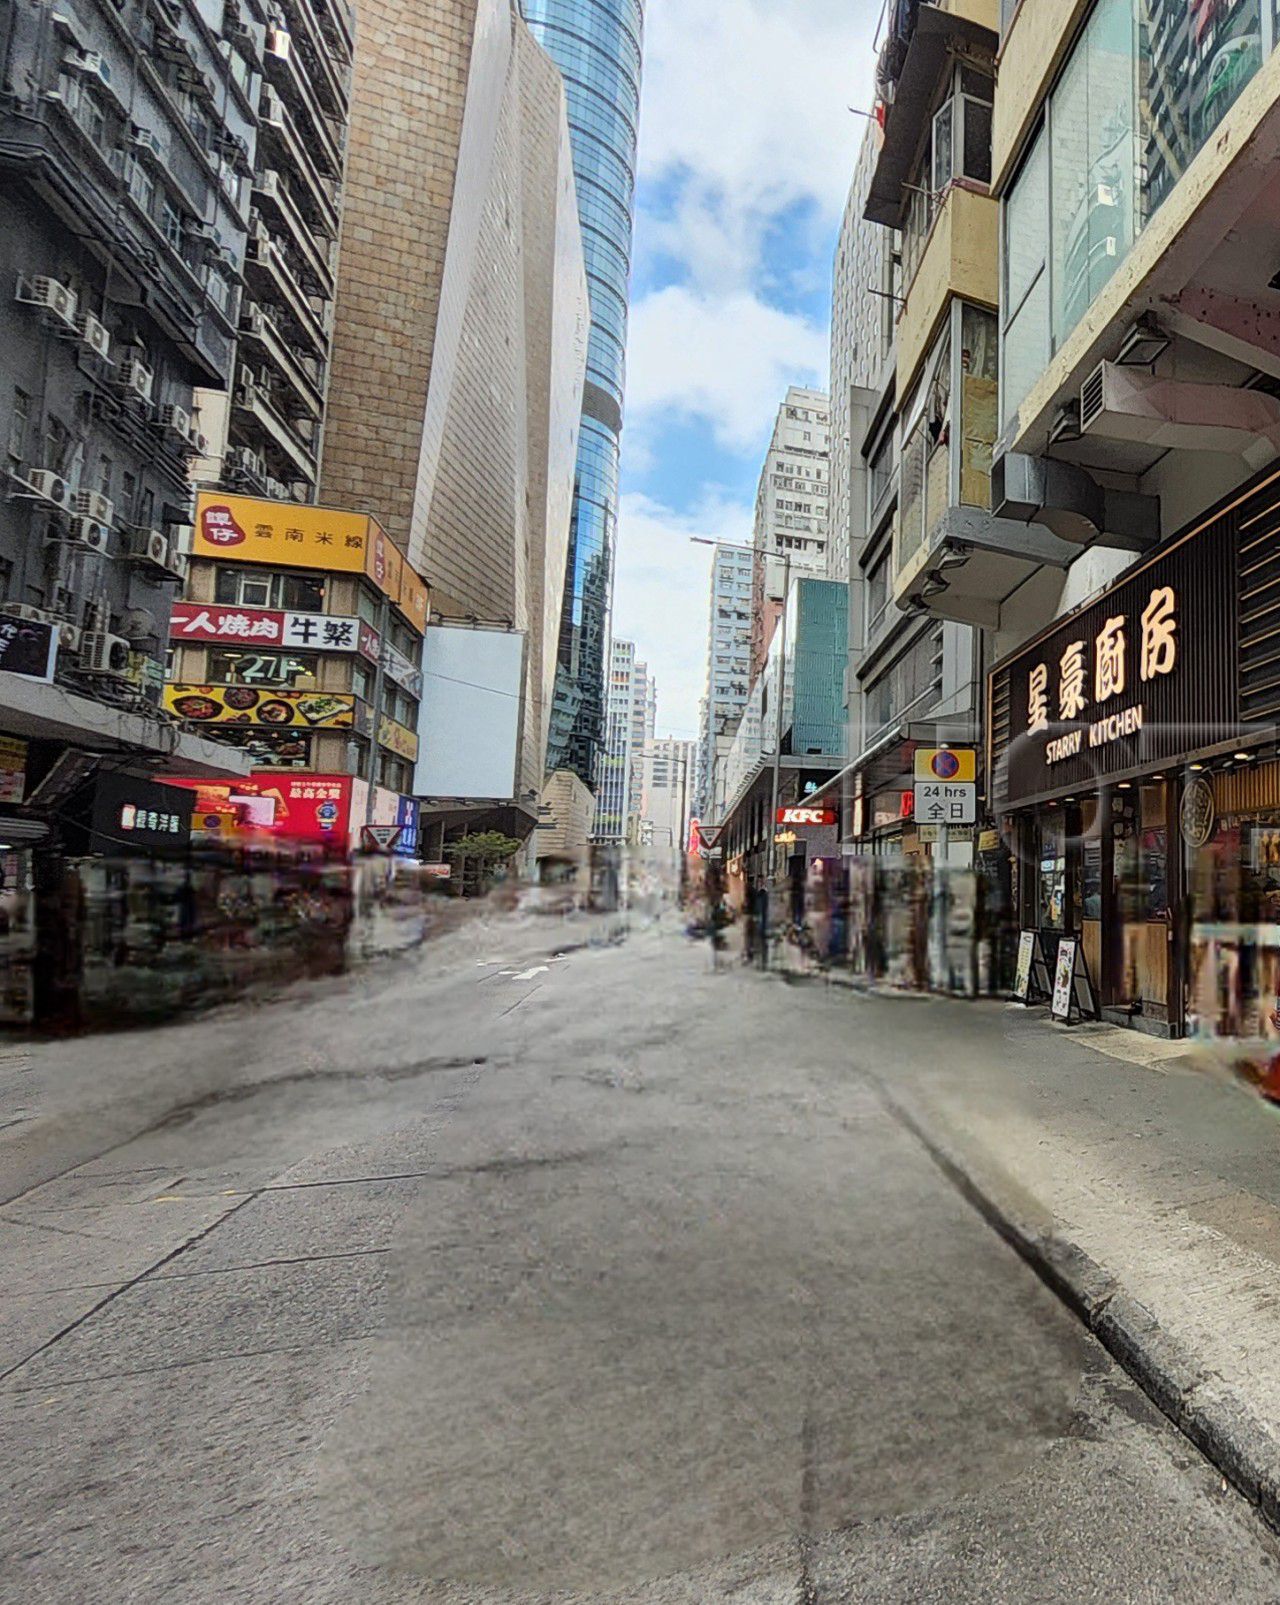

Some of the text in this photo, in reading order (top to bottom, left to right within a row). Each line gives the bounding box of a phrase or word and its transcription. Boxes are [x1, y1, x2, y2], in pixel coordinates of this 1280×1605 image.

[205, 511, 238, 542] 譚仔
[254, 523, 364, 549] 雲南米線
[291, 616, 354, 646] 牛繁
[1027, 586, 1177, 737] 星豪廚房
[1046, 704, 1143, 765] STARRY KITCHEN
[924, 786, 966, 797] 24 hrs
[782, 808, 823, 823] KFC
[928, 802, 964, 820] 全日
